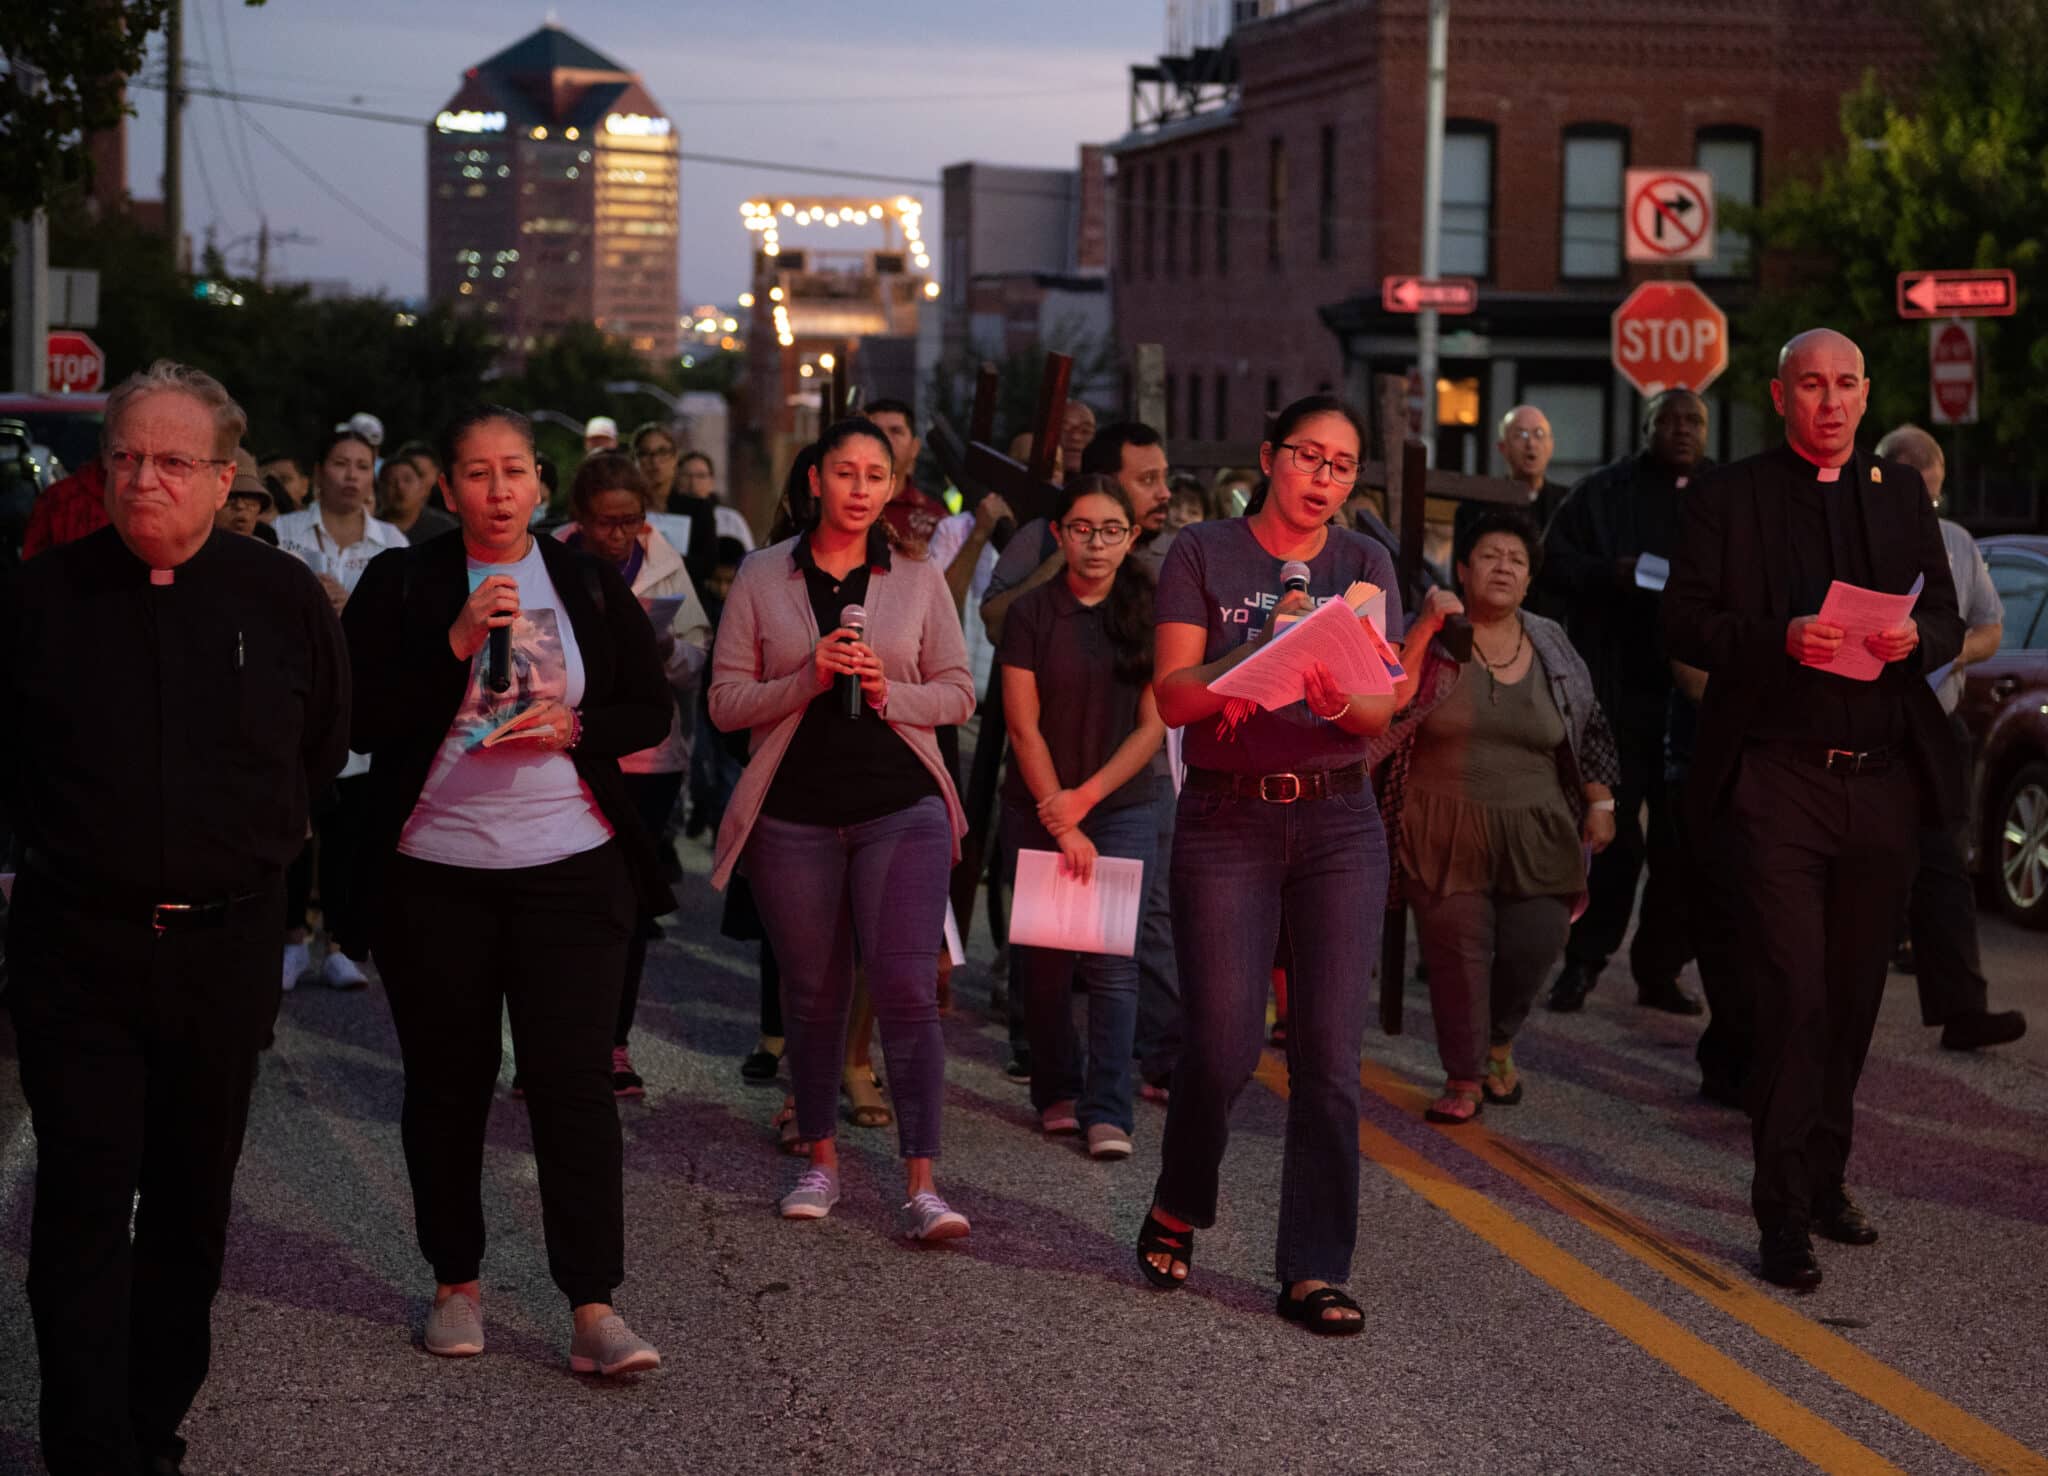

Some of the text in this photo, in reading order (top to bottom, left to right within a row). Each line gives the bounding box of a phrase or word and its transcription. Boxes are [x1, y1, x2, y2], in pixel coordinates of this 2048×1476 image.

[1622, 319, 1717, 362] STOP
[48, 354, 97, 383] TOP
[1220, 606, 1249, 623] YO
